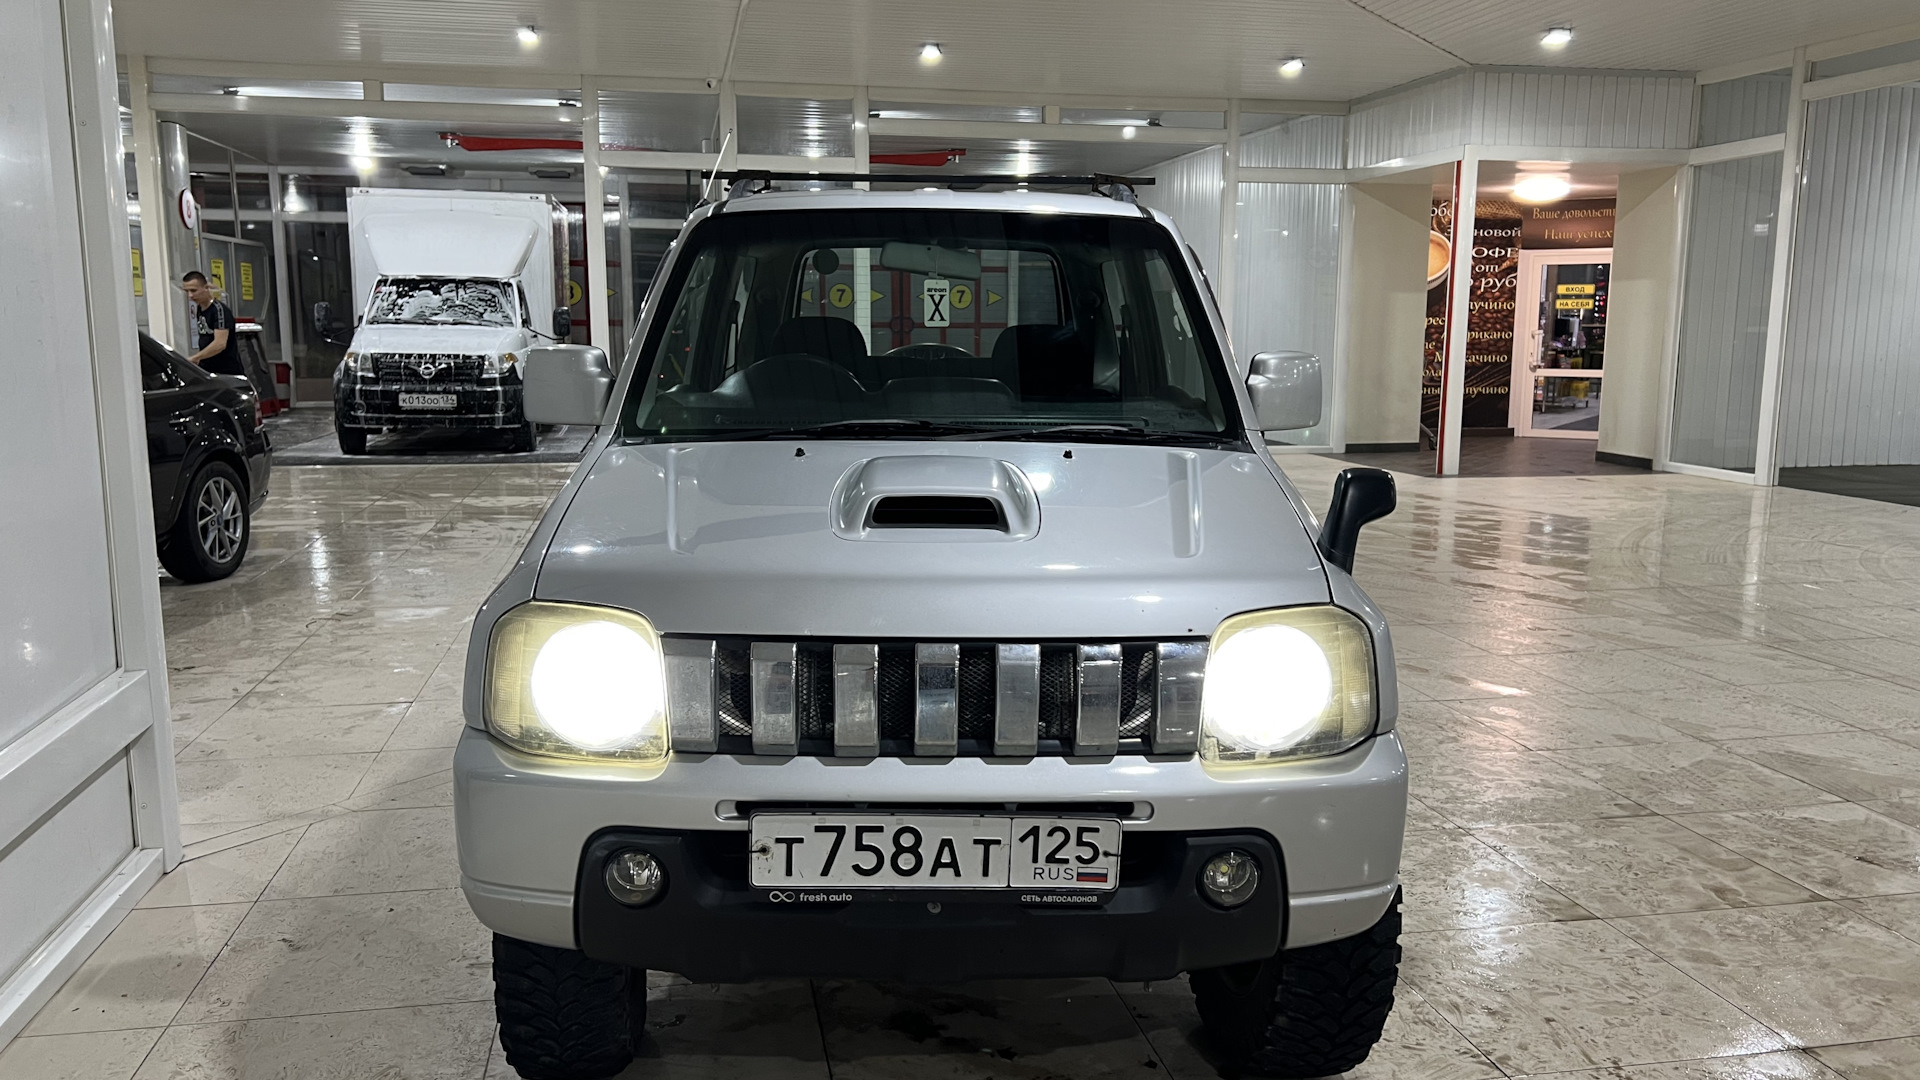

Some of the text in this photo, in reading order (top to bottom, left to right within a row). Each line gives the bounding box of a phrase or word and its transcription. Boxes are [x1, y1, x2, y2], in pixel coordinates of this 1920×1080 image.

[1533, 207, 1560, 219] Ваше
[1545, 229, 1573, 239] Наш
[1472, 247, 1519, 258] ОФЕ
[836, 288, 846, 303] 7
[956, 290, 965, 304] 7
[927, 294, 947, 322] X
[774, 825, 1002, 878] Т758АТ
[1018, 825, 1100, 865] 125
[1033, 867, 1074, 880] RUS
[800, 892, 852, 902] fresh auto
[1021, 894, 1098, 903] СЕТЬ АВТОСАЛОНОВ
